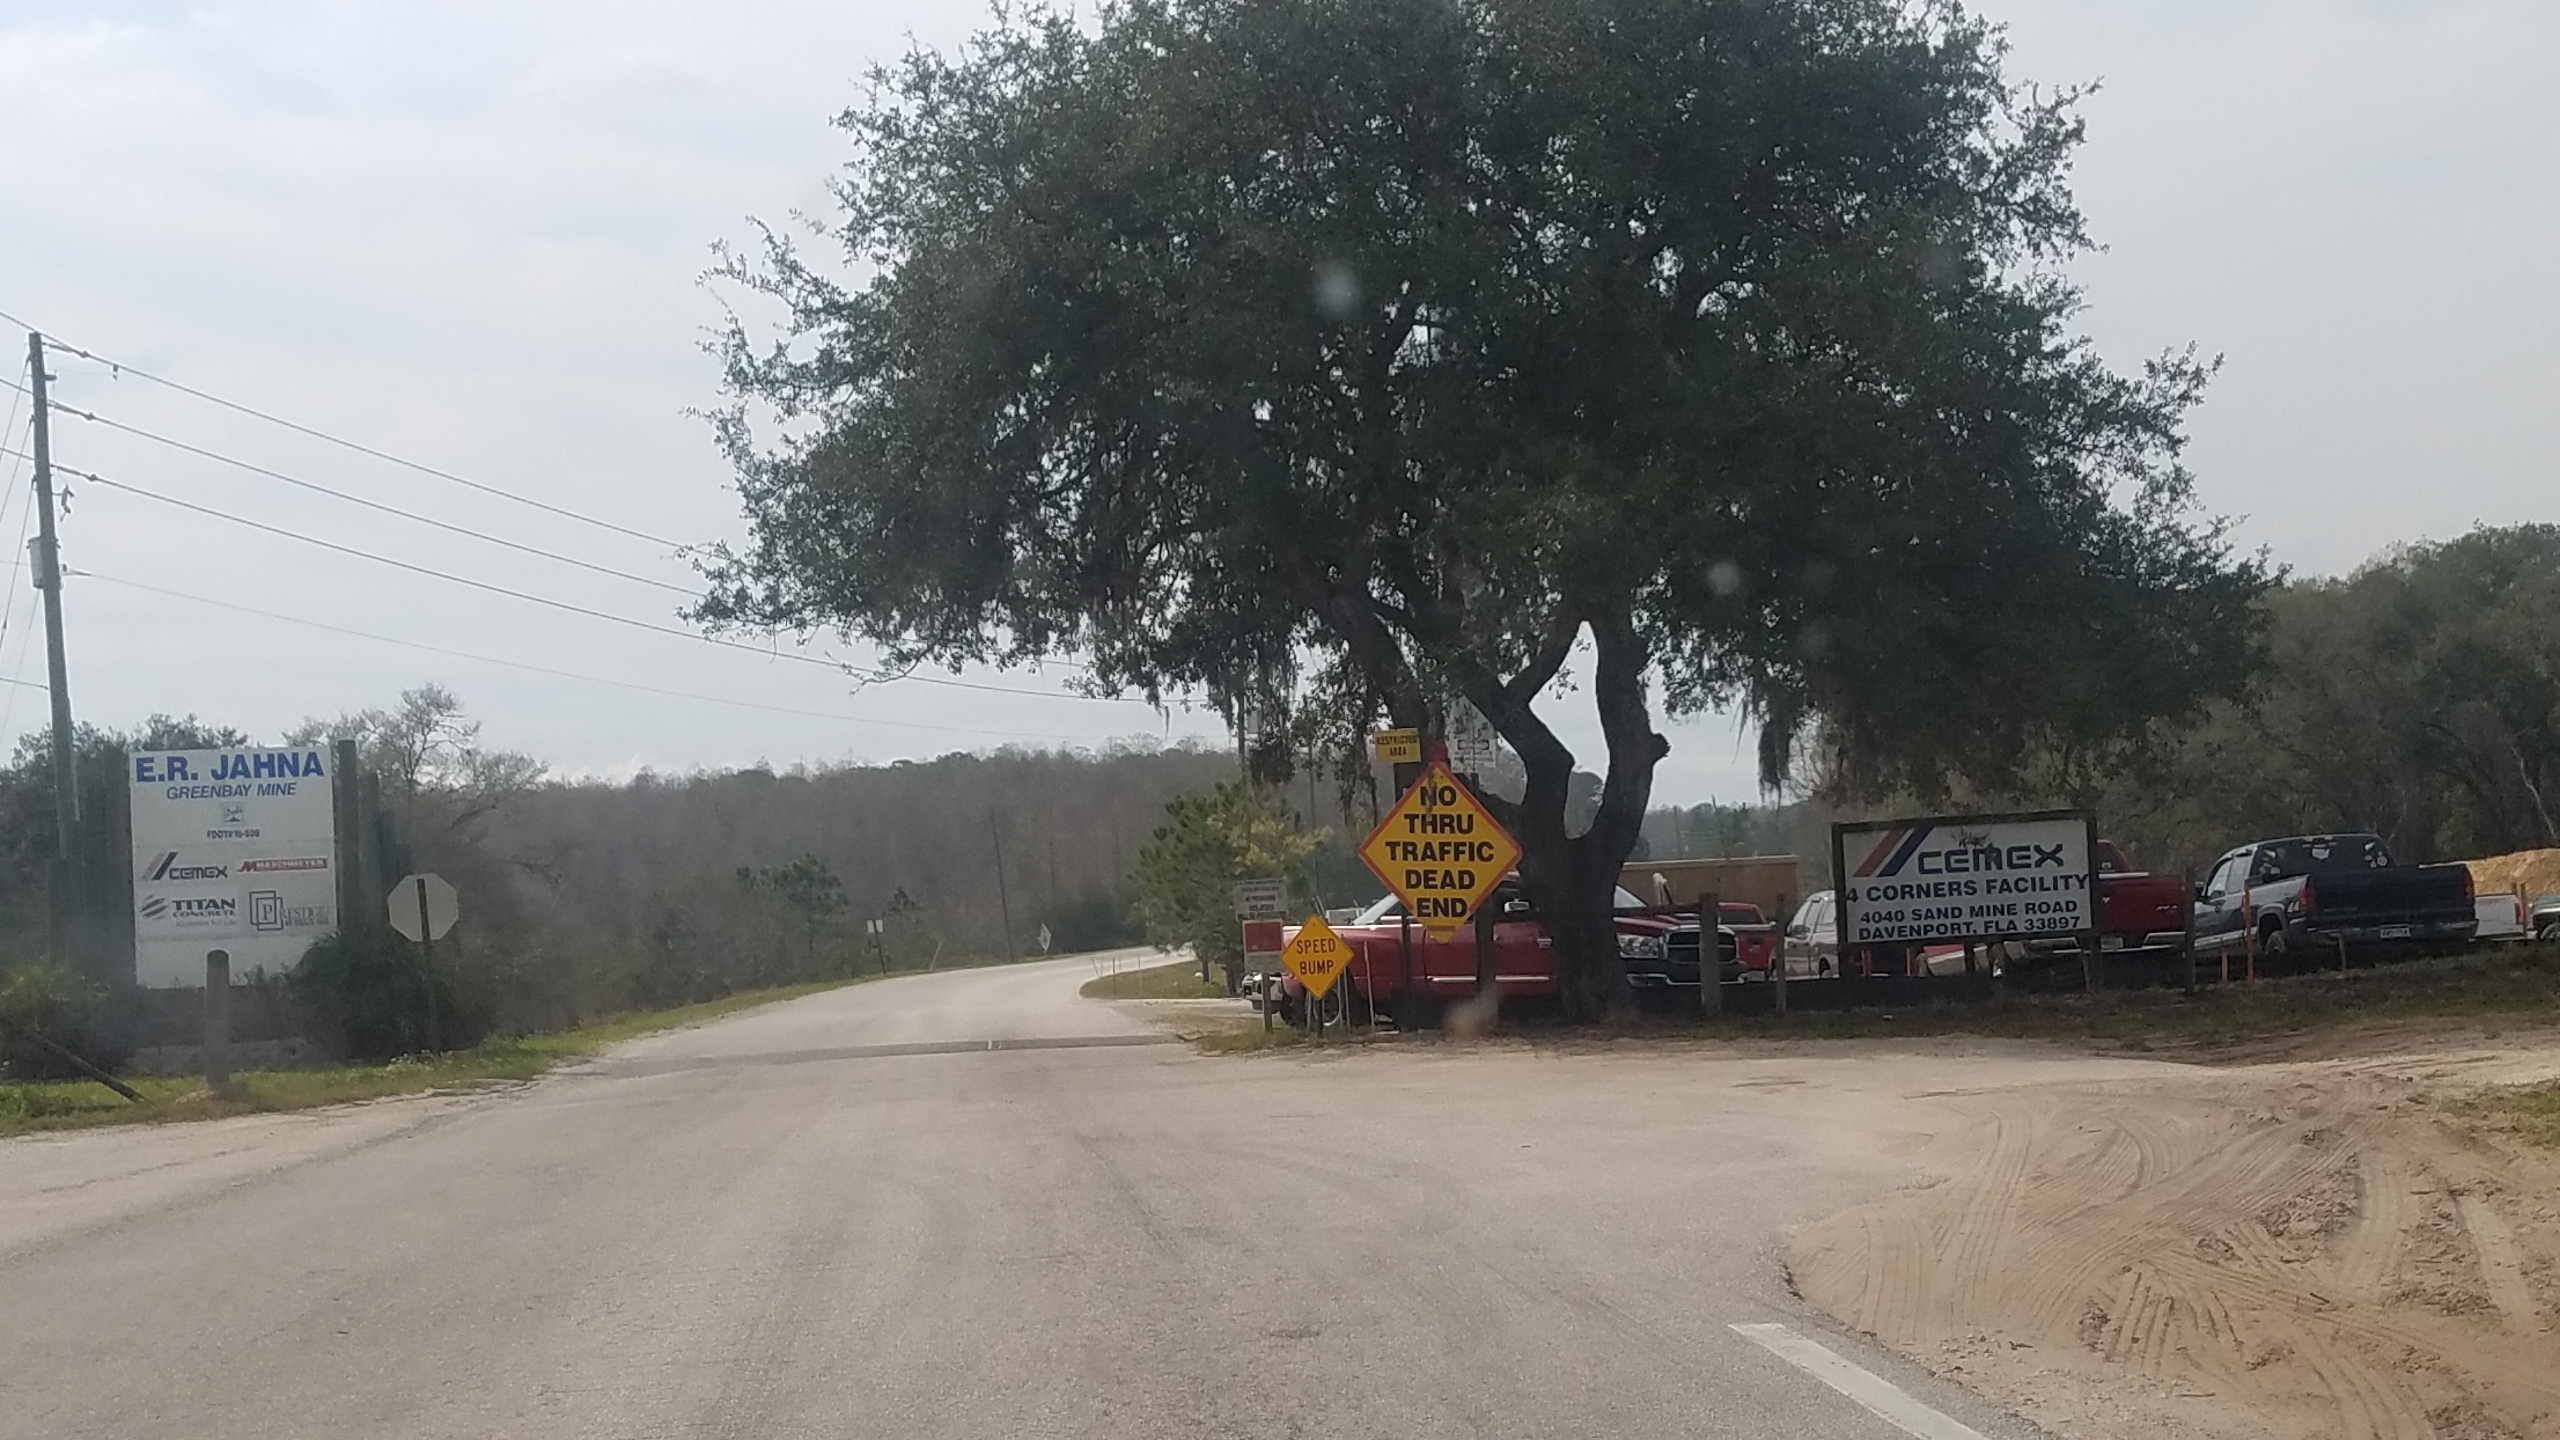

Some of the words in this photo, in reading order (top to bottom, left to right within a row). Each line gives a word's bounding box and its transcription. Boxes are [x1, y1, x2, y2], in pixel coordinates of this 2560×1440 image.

[136, 756, 199, 783] E.R.
[210, 752, 324, 781] JAHNA
[166, 784, 252, 800] GREENBAY
[256, 782, 297, 797] MINE
[1420, 785, 1457, 807] NO
[1404, 813, 1474, 834] THRU
[1385, 841, 1495, 862] TRAFFIC
[1918, 843, 2065, 875] CEMEX
[168, 865, 229, 881] CEMEX
[1405, 869, 1475, 890] DEAD
[1846, 887, 1860, 902] 4
[1866, 879, 1978, 902] CORNERS
[1985, 873, 2089, 895] FACILITY
[172, 898, 236, 911] TITAN
[172, 910, 235, 918] CONCRETE
[1416, 897, 1468, 918] END
[1860, 910, 1905, 924] 4040
[1911, 906, 1963, 922] SAND
[1970, 903, 2018, 918] MINE
[2024, 900, 2078, 916] ROAD
[1984, 919, 2018, 934] FLA
[2024, 916, 2081, 932] 33897
[1296, 938, 1336, 955] SPEED
[1300, 960, 1334, 975] BUMP
